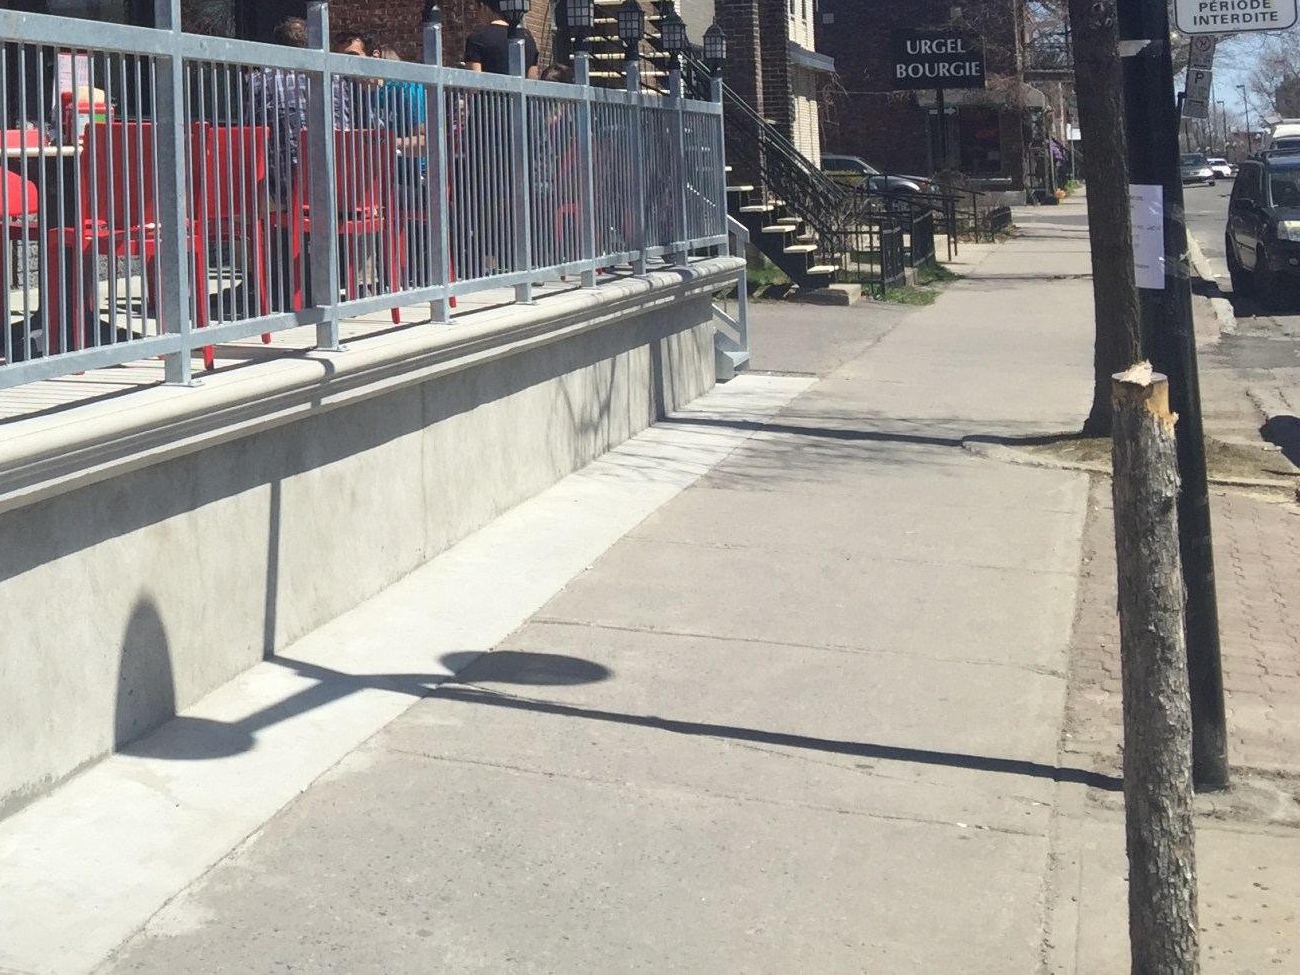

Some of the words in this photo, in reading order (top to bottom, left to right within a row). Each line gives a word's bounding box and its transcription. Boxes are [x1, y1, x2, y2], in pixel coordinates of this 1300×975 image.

[1193, 11, 1279, 26] INTERDITE
[906, 38, 967, 55] URGEL
[896, 61, 981, 79] BOURGIE
